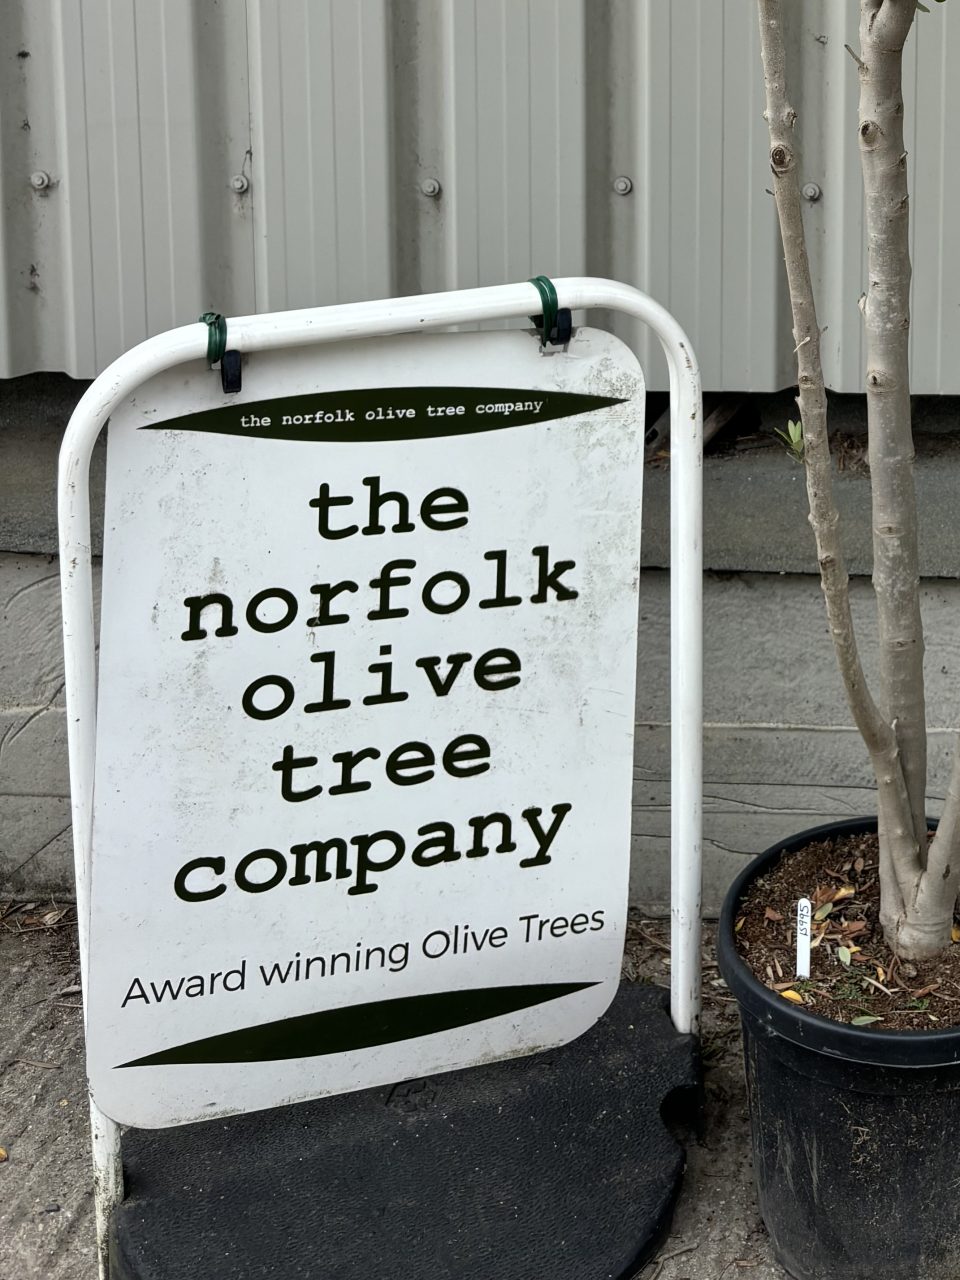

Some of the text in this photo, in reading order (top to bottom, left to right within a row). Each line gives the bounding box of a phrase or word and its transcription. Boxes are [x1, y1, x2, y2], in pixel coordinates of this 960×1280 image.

[240, 401, 543, 428] the norfolk olive tree company
[308, 475, 469, 541] the
[180, 545, 579, 642] norfolk
[241, 644, 522, 721] olive
[271, 733, 491, 803] tree
[173, 802, 573, 903] company
[121, 910, 605, 1008] Award winning Olive Trees
